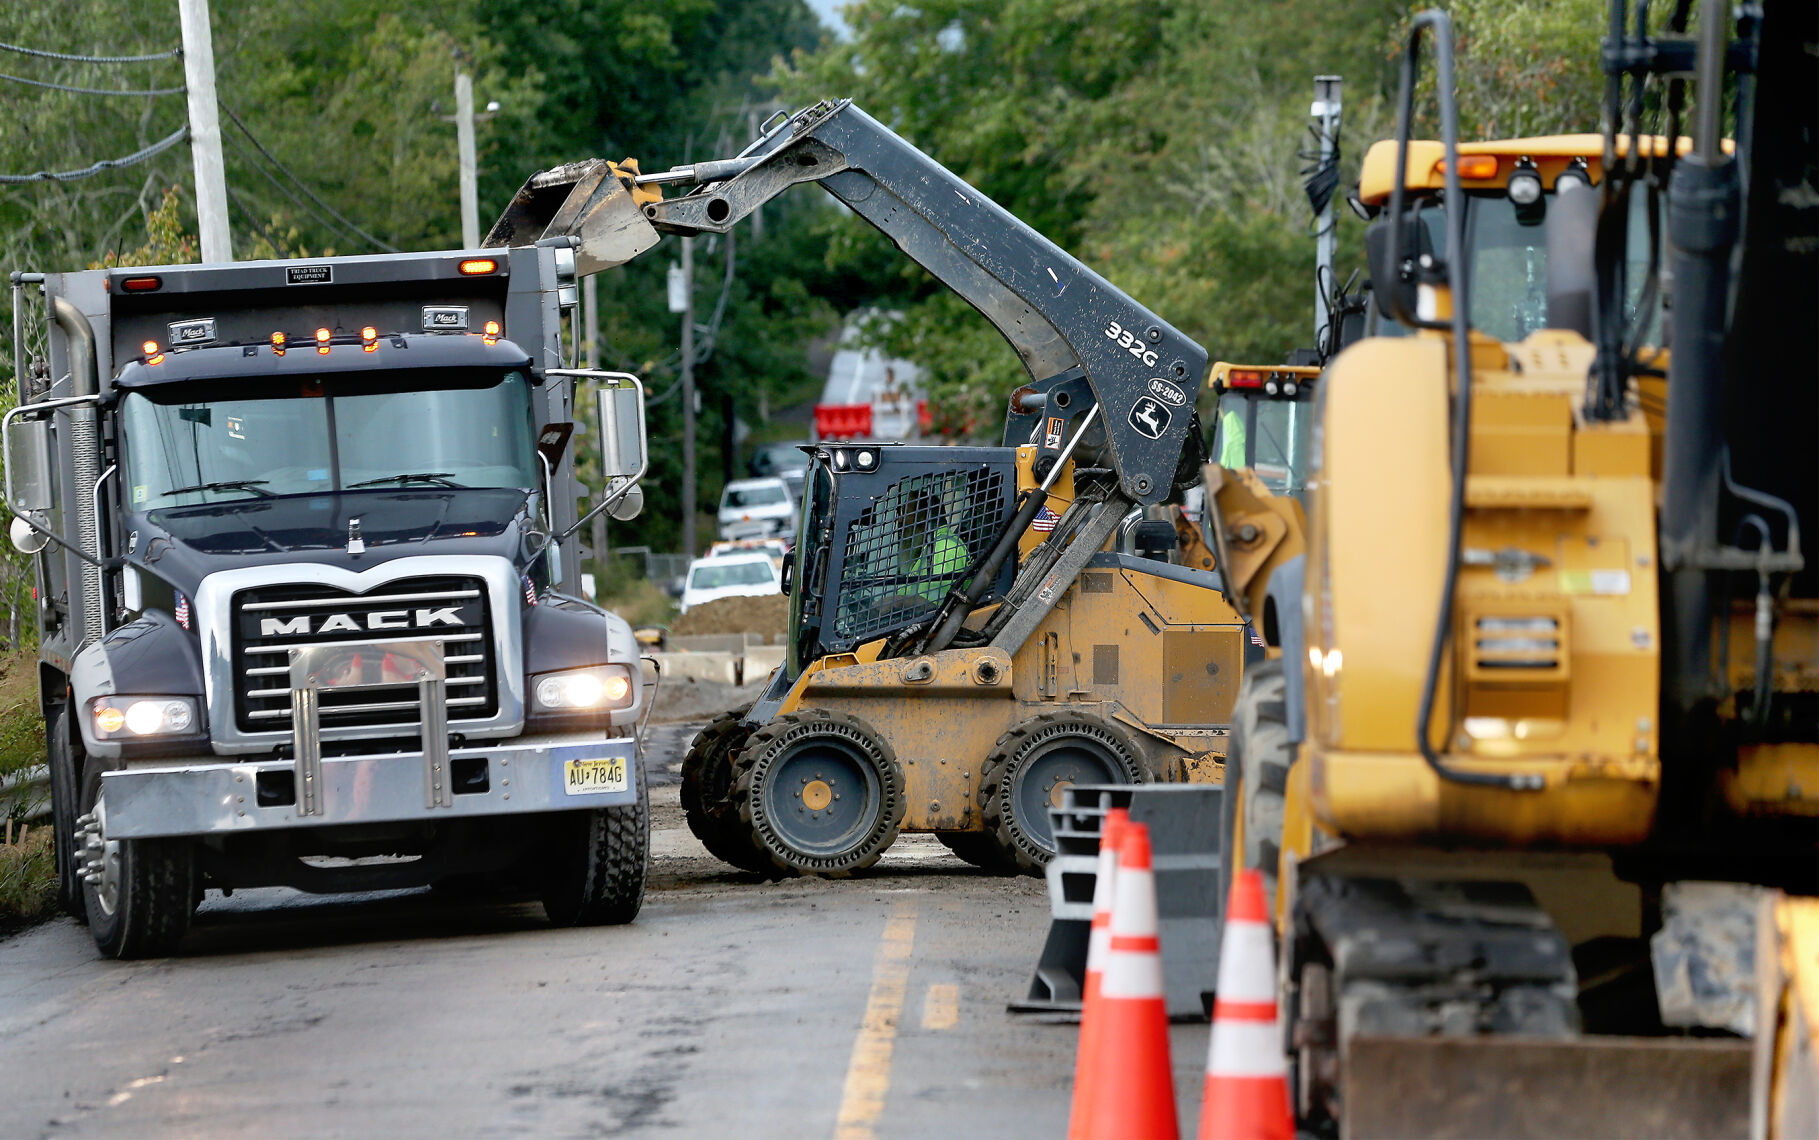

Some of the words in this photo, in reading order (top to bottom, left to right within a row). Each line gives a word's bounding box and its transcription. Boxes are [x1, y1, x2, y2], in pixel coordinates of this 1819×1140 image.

[435, 313, 457, 323] Mack
[182, 328, 205, 338] Mack
[1104, 321, 1159, 368] 332G
[1151, 380, 1184, 404] SS-2042
[260, 606, 465, 636] MACK
